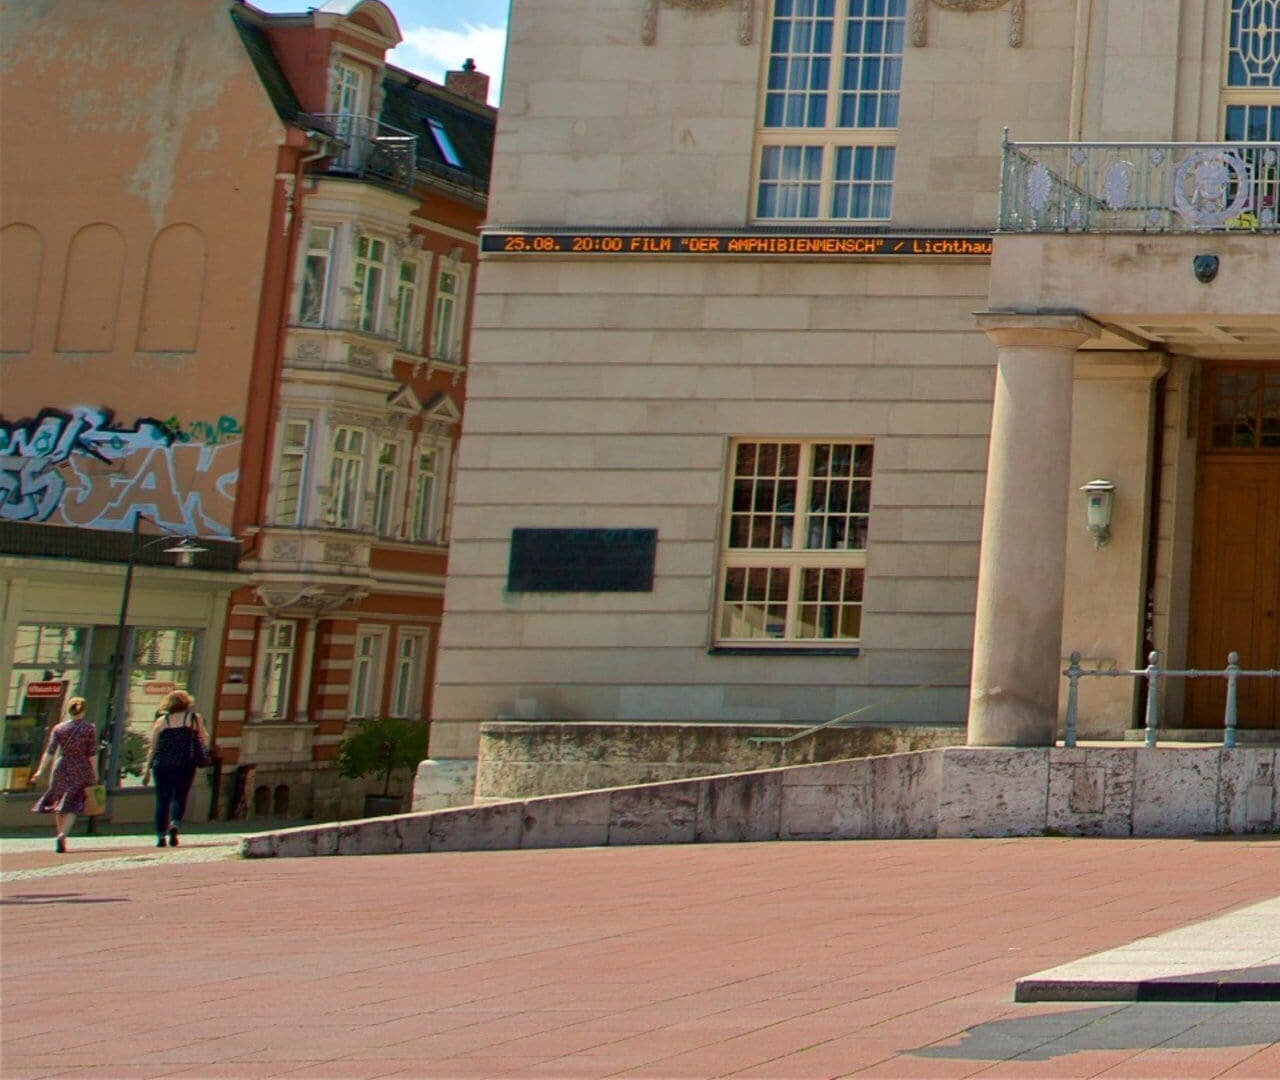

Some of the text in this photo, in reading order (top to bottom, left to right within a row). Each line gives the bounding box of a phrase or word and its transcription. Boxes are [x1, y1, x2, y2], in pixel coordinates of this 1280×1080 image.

[504, 237, 561, 251] 25.08.
[572, 237, 622, 251] 20:00
[630, 237, 671, 251] FILM
[727, 238, 884, 253] AMPHIBIENMENSCH"
